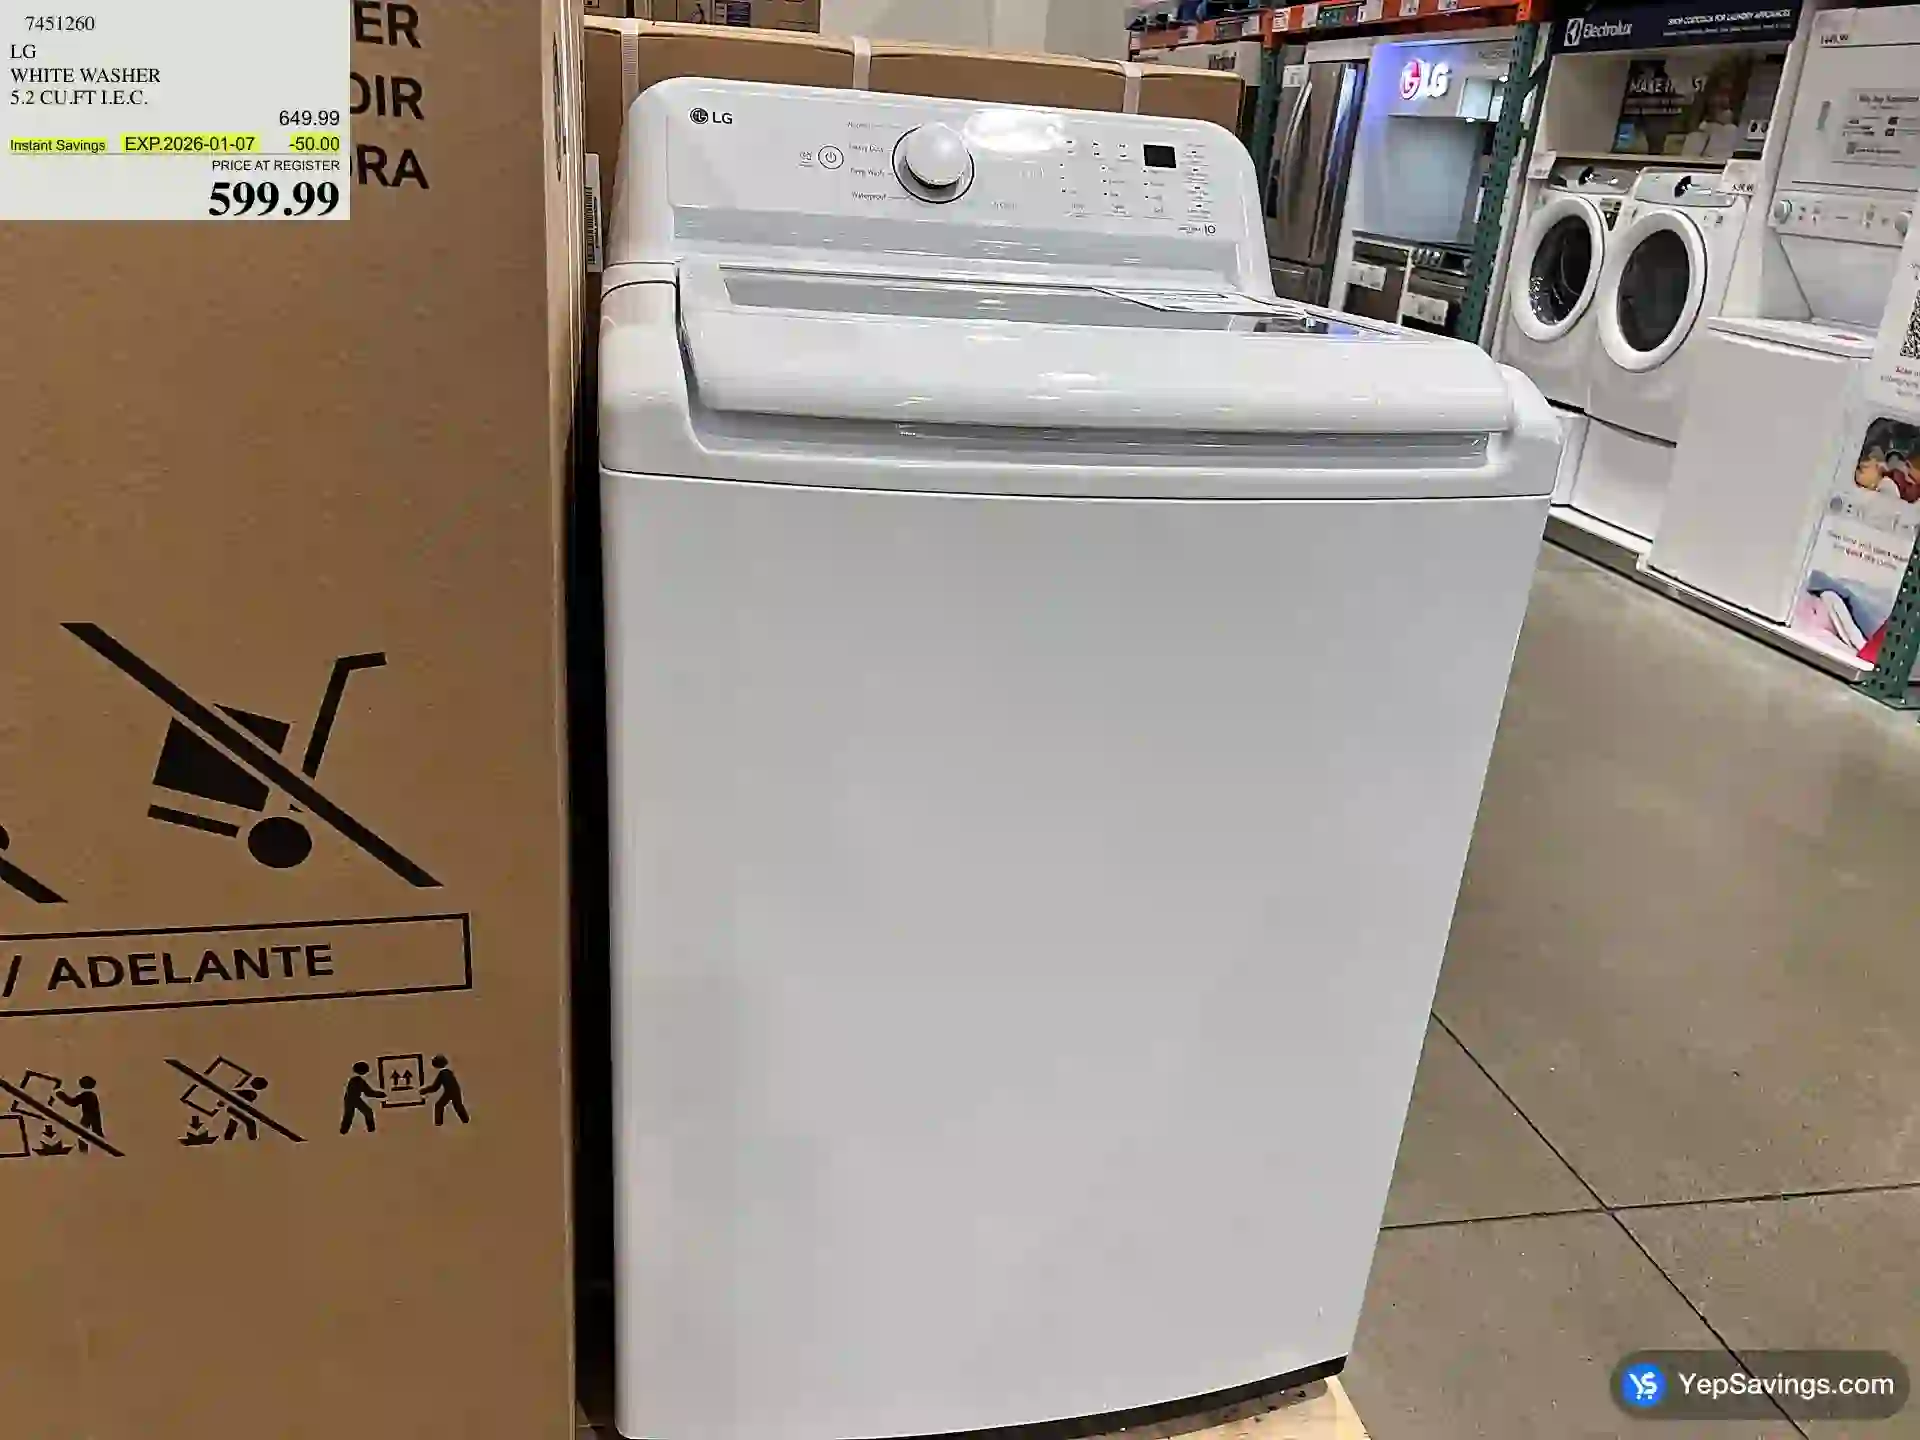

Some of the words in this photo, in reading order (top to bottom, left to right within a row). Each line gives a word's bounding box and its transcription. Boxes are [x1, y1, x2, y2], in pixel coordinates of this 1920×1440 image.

[353, 1, 421, 48] ER
[1584, 19, 1632, 38] Electrolux
[1419, 61, 1449, 97] LG
[713, 112, 732, 124] LG
[350, 144, 429, 189] RA
[48, 943, 334, 991] ADELANTE
